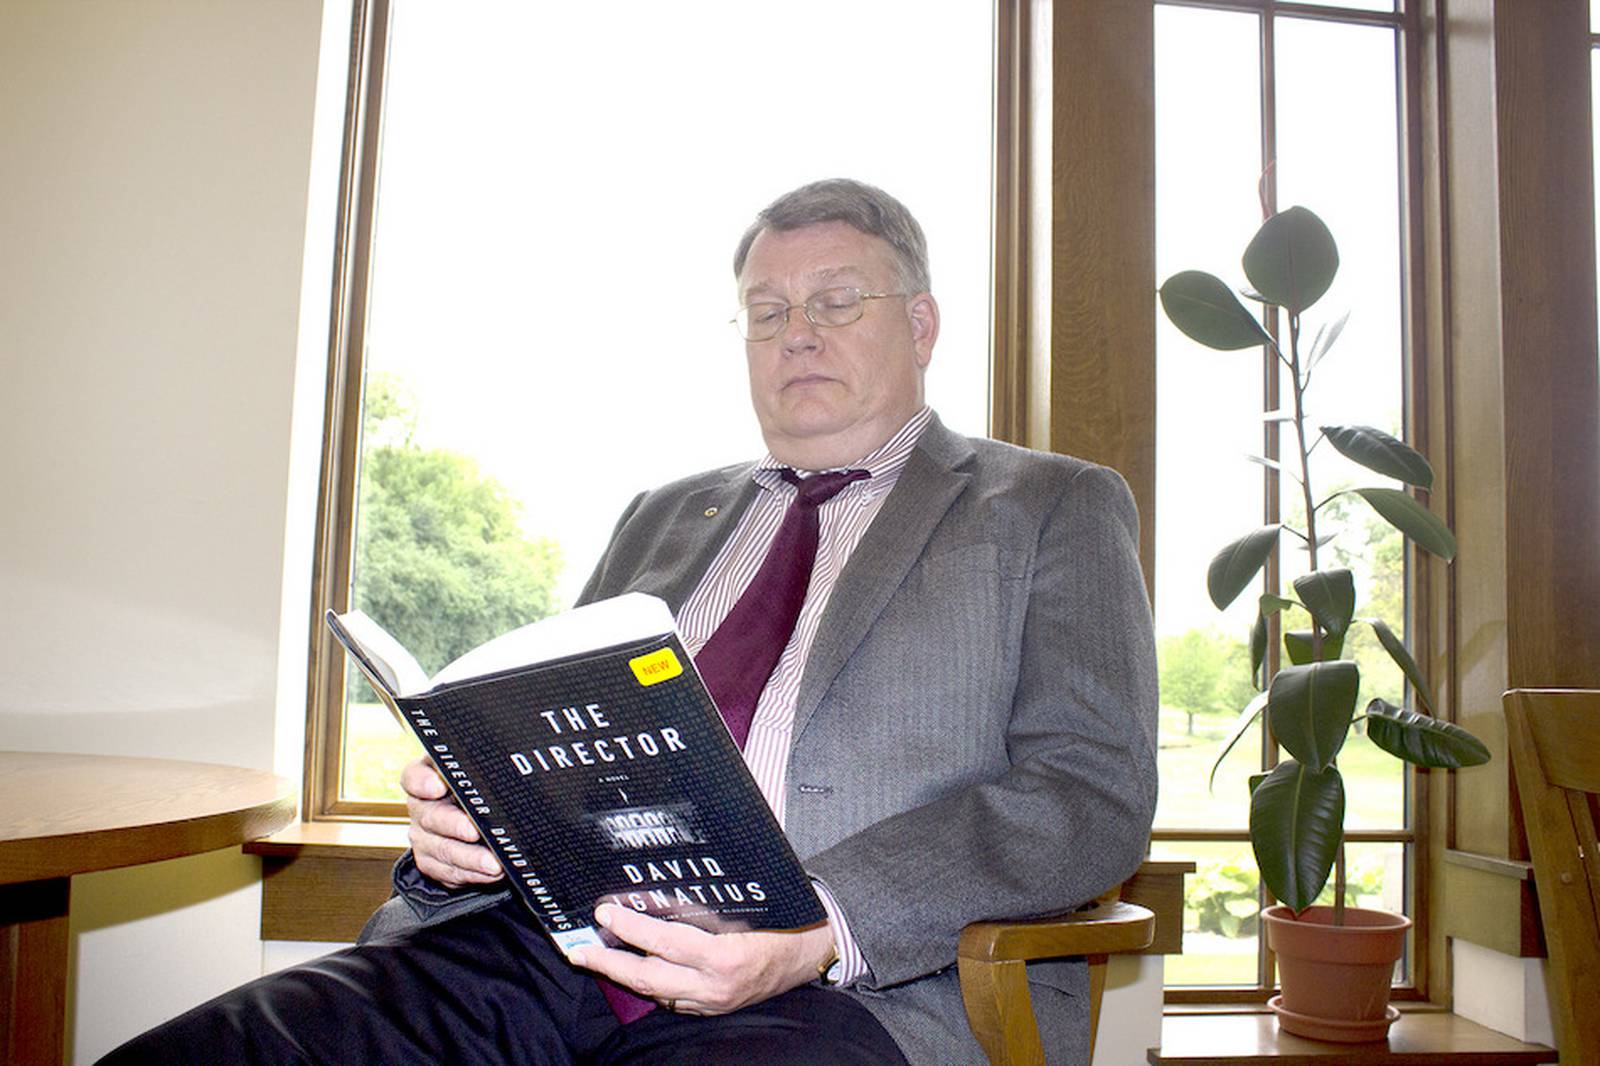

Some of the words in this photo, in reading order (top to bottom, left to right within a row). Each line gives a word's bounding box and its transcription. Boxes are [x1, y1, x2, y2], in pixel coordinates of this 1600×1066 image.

[642, 660, 670, 676] NEW
[540, 703, 610, 734] THE
[510, 727, 687, 776] DIRECTOR
[411, 709, 438, 736] THE
[433, 744, 490, 814] DIRECTOR
[491, 828, 527, 867] DAVID
[522, 872, 572, 930] IGNATIUS
[622, 857, 725, 884] DAVID
[612, 882, 766, 911] IGNATIUS
